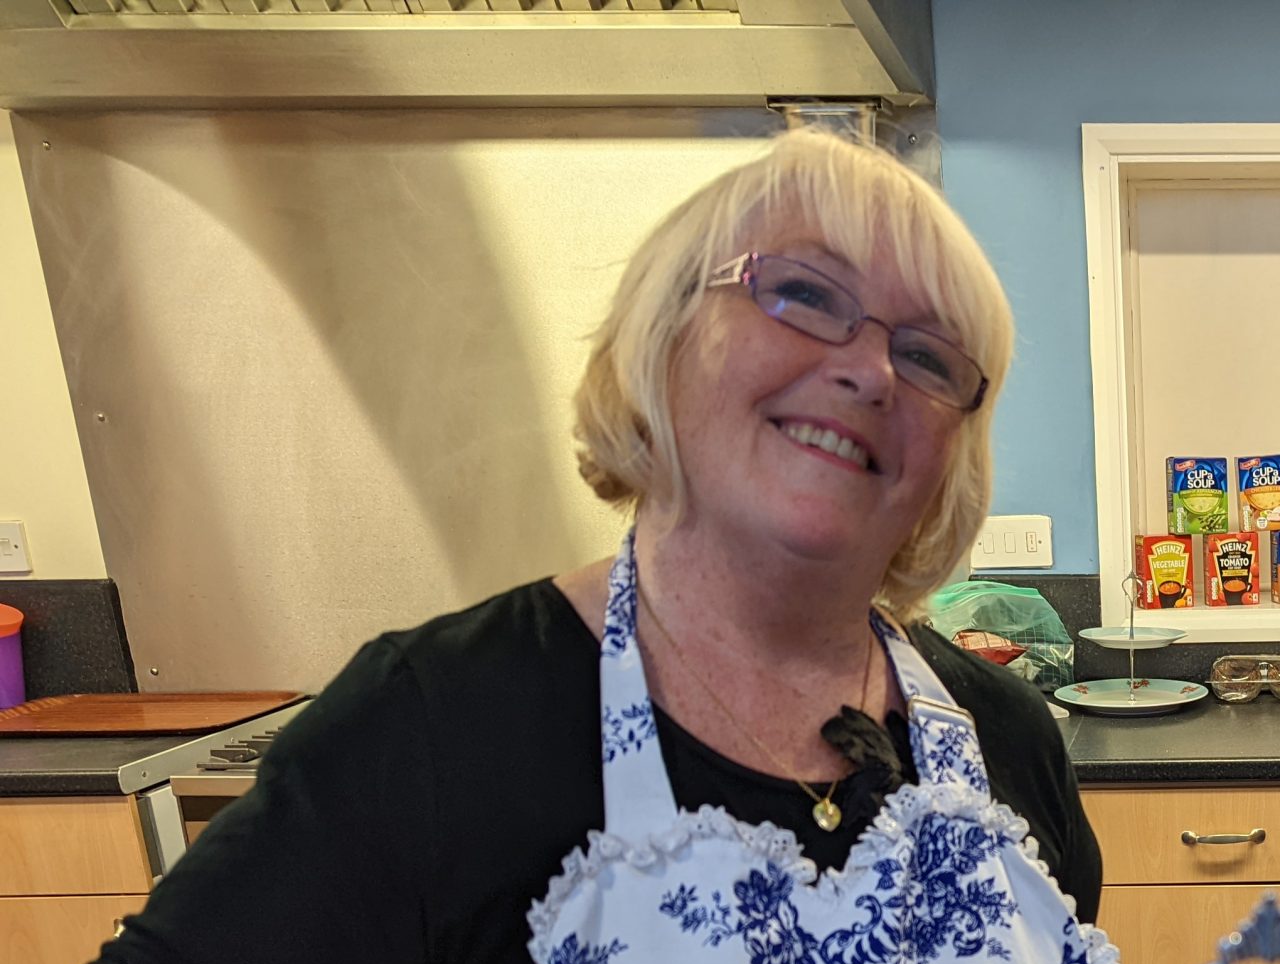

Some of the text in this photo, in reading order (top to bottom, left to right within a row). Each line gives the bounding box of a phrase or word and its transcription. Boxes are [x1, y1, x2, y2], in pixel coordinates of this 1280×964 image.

[1187, 479, 1214, 489] SOUP
[1253, 476, 1280, 486] SOUP
[1156, 545, 1181, 554] HEINZ
[1222, 542, 1247, 553] HEINZ
[1152, 560, 1185, 569] VEGETABLE
[1220, 558, 1249, 567] TOMATO
